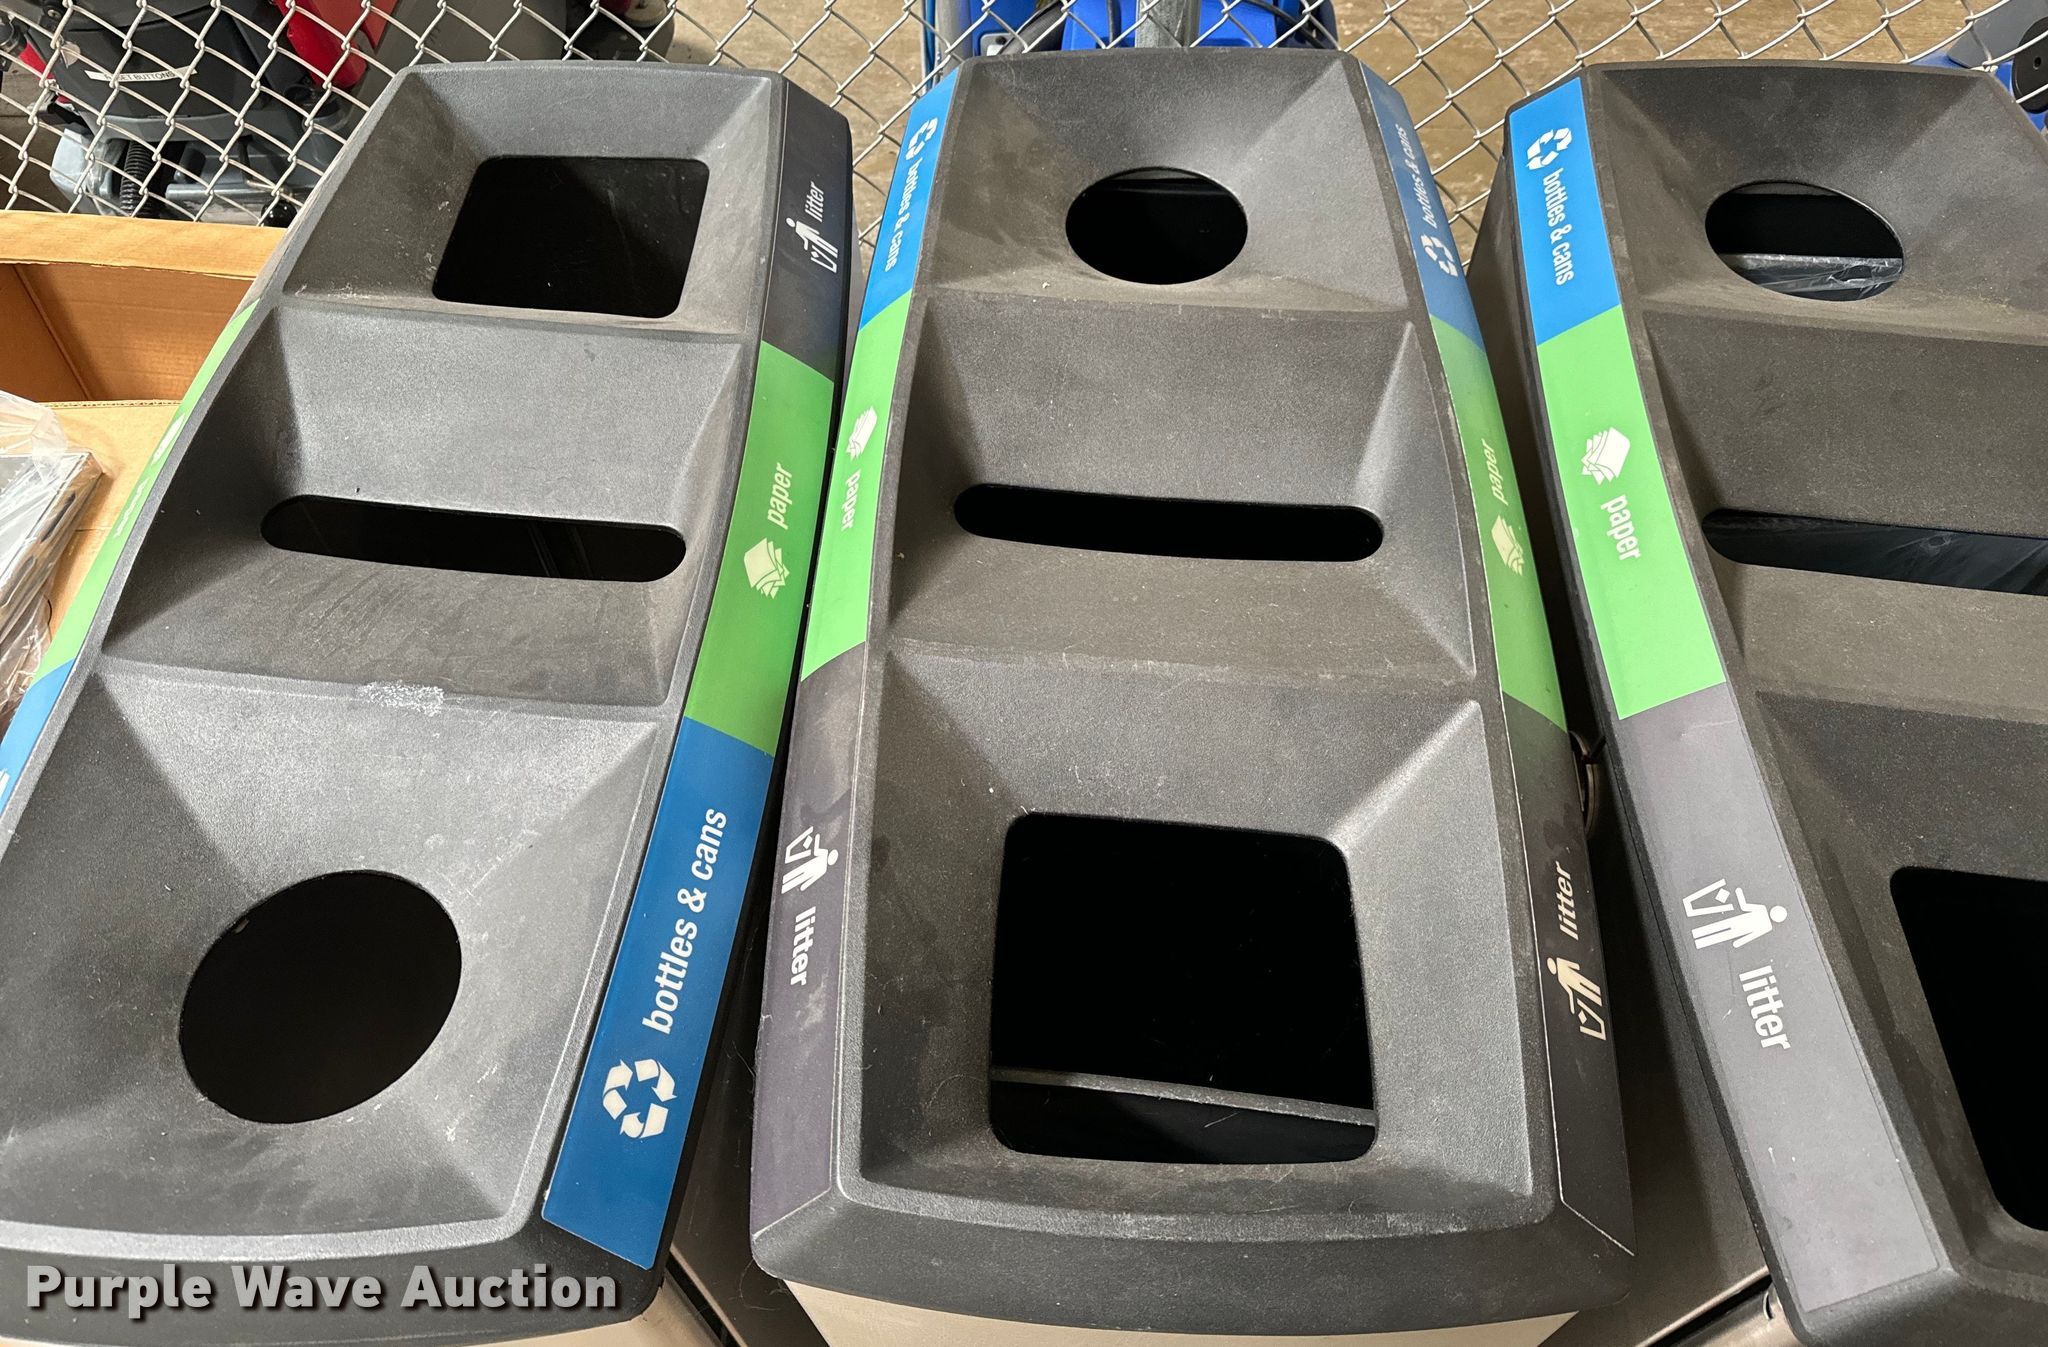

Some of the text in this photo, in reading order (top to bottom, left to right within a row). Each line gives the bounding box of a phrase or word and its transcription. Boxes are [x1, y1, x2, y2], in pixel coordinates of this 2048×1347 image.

[135, 71, 175, 80] BUTTONS
[804, 180, 824, 223] litter
[885, 157, 923, 272] bottles & cans
[1395, 124, 1437, 229] bottles & cans
[1543, 167, 1574, 286] bottles & cans
[767, 461, 793, 530] paper
[841, 469, 861, 531] paper
[1481, 438, 1508, 506] paper
[1600, 494, 1641, 560] paper
[642, 807, 727, 1035] bottles & cans
[1555, 860, 1579, 941] litter
[790, 906, 816, 986] litter
[1739, 965, 1791, 1050] litter
